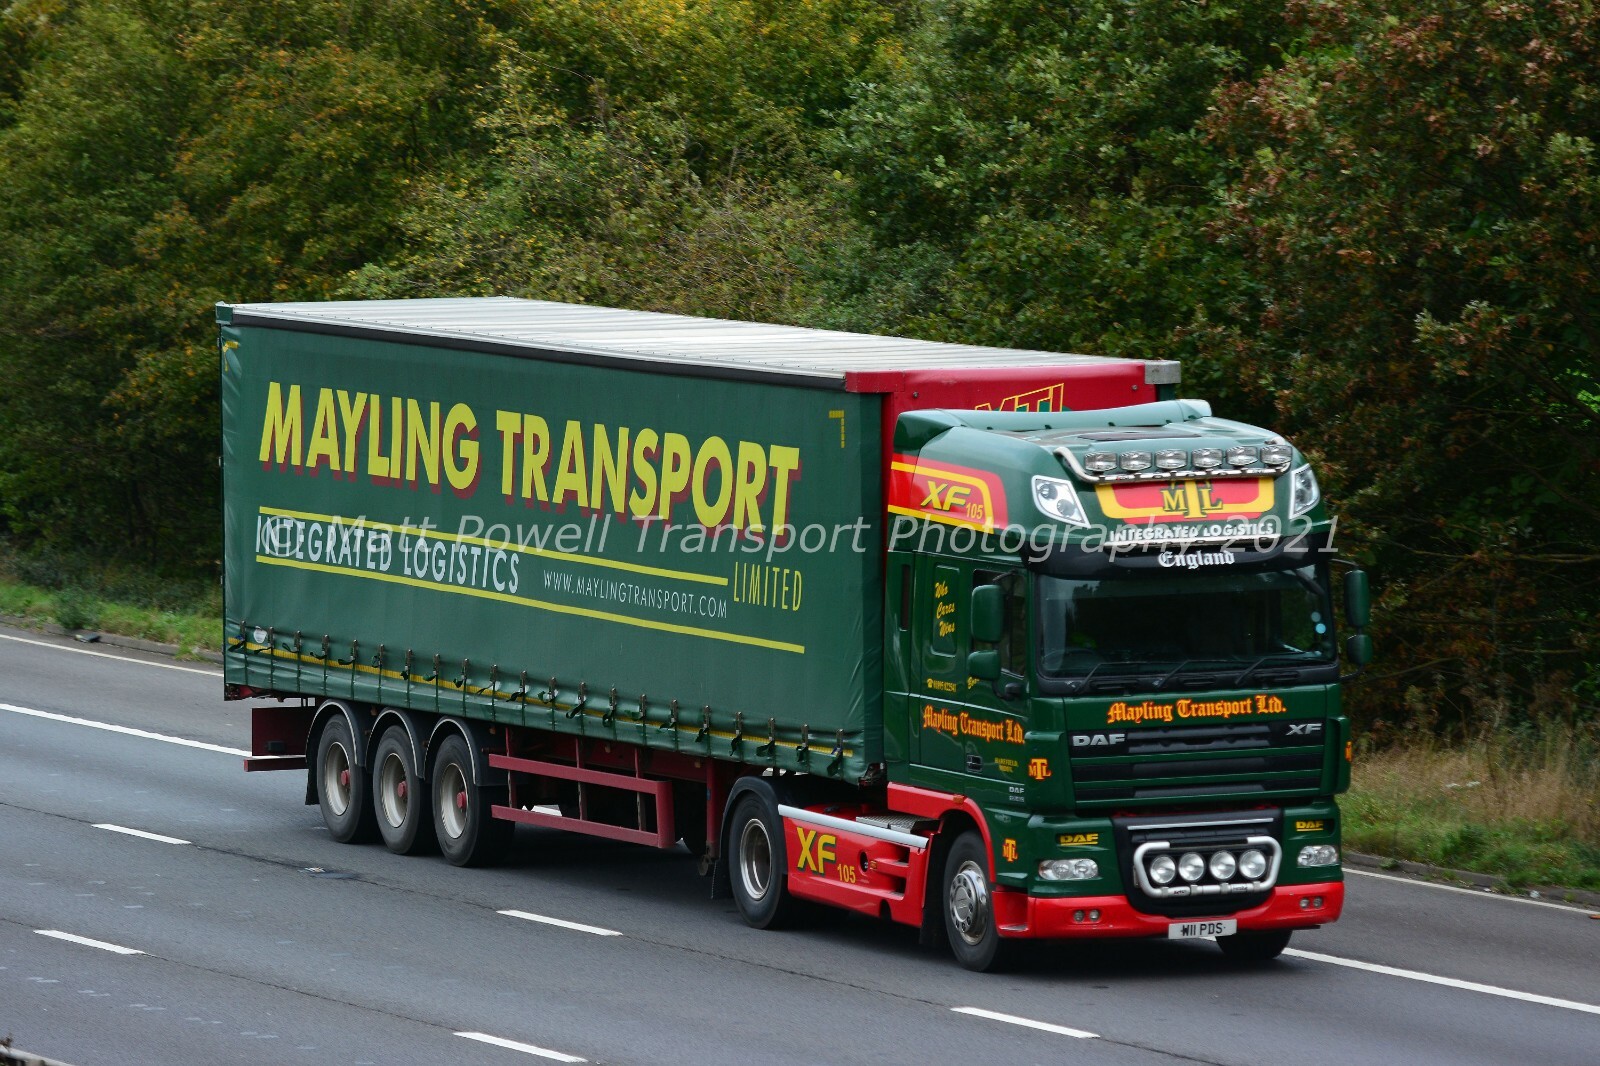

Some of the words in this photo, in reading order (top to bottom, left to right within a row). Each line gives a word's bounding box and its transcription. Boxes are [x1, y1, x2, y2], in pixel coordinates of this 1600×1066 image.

[259, 381, 481, 498] MAYLING
[496, 409, 801, 546] TRANSPORT
[920, 480, 972, 512] XF
[965, 503, 985, 521] 105
[1109, 523, 1200, 543] INTEGRATED
[1203, 520, 1274, 538] LOGISTICS
[255, 515, 393, 572] INTEGRATED
[403, 536, 520, 594] LOGISTICS
[1157, 550, 1236, 570] England
[543, 569, 728, 619] WWW.MAYLINGTRANSPORT.COM
[733, 561, 803, 612] LIMITED
[1107, 702, 1174, 724] Mayling
[1176, 697, 1253, 719] Transport
[1254, 694, 1287, 714] Ltd.
[923, 704, 959, 737] Mayling
[960, 712, 1004, 743] Transport
[1005, 719, 1026, 745] Ltd.
[1285, 723, 1323, 736] XF
[1072, 733, 1126, 747] DAF
[1028, 757, 1053, 781] MTL
[1008, 786, 1025, 794] DAF
[1296, 820, 1324, 829] DAF
[1060, 833, 1099, 844] DAF
[796, 826, 837, 876] XF
[837, 863, 856, 884] 105
[1199, 922, 1224, 935] PDS
